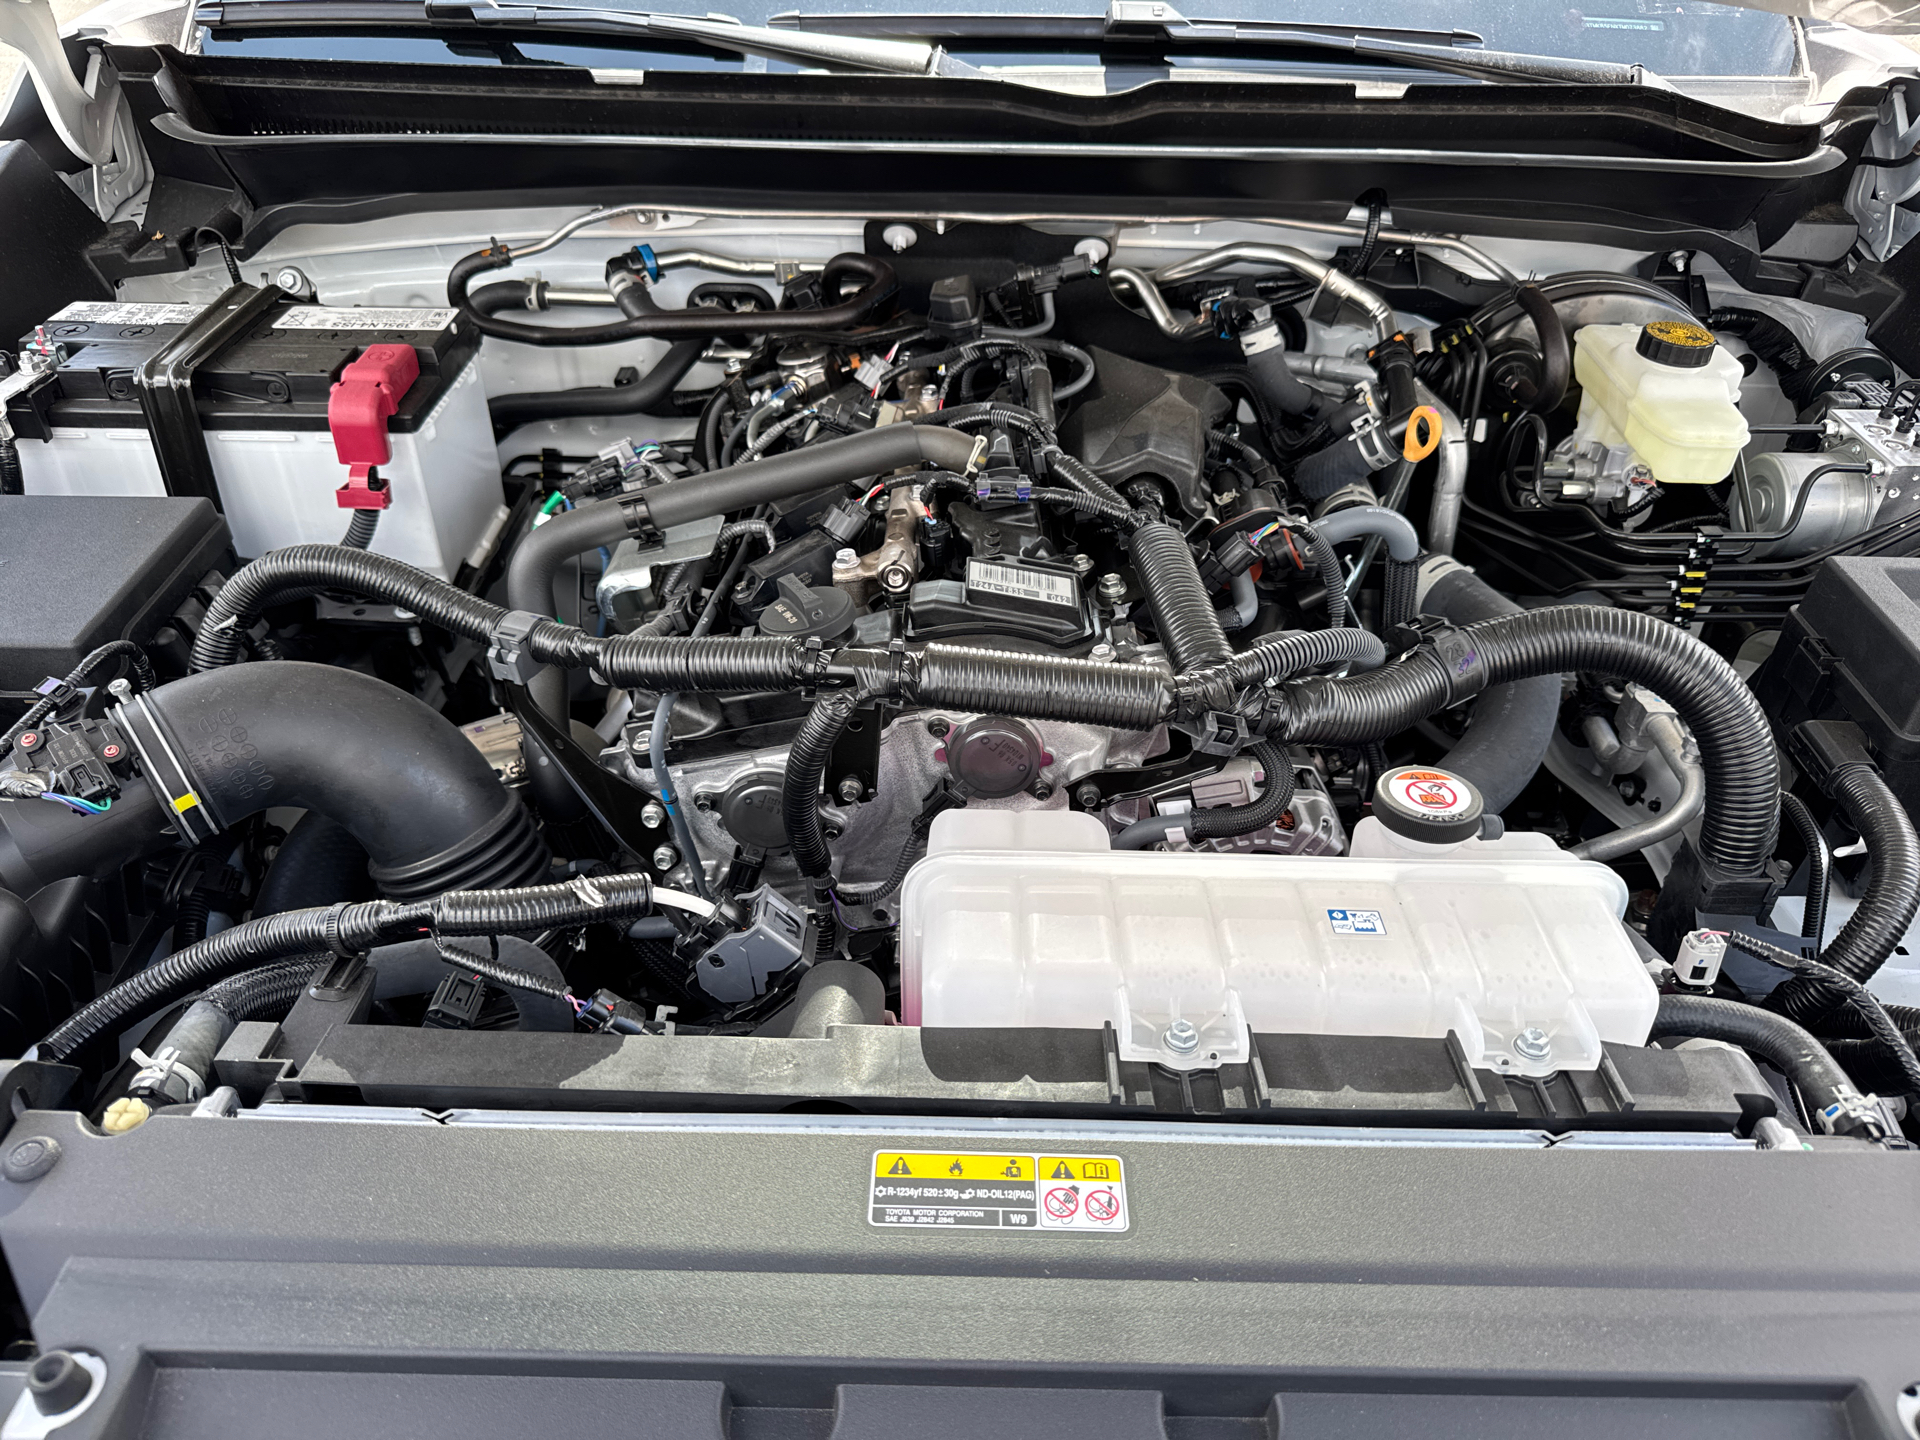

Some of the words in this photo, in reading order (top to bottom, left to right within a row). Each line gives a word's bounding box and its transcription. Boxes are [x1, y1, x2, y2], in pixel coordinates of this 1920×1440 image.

[1050, 594, 1068, 603] 042
[1418, 812, 1466, 823] DENSO
[887, 1187, 922, 1199] R-1234yf
[923, 1188, 959, 1200] 520±30g
[976, 1188, 1034, 1201] ND-OIL12(PAG)
[885, 1208, 911, 1216] TOYOTA
[913, 1209, 937, 1217] MOTOR
[938, 1210, 984, 1218] CORPORATION
[1010, 1213, 1028, 1225] W9
